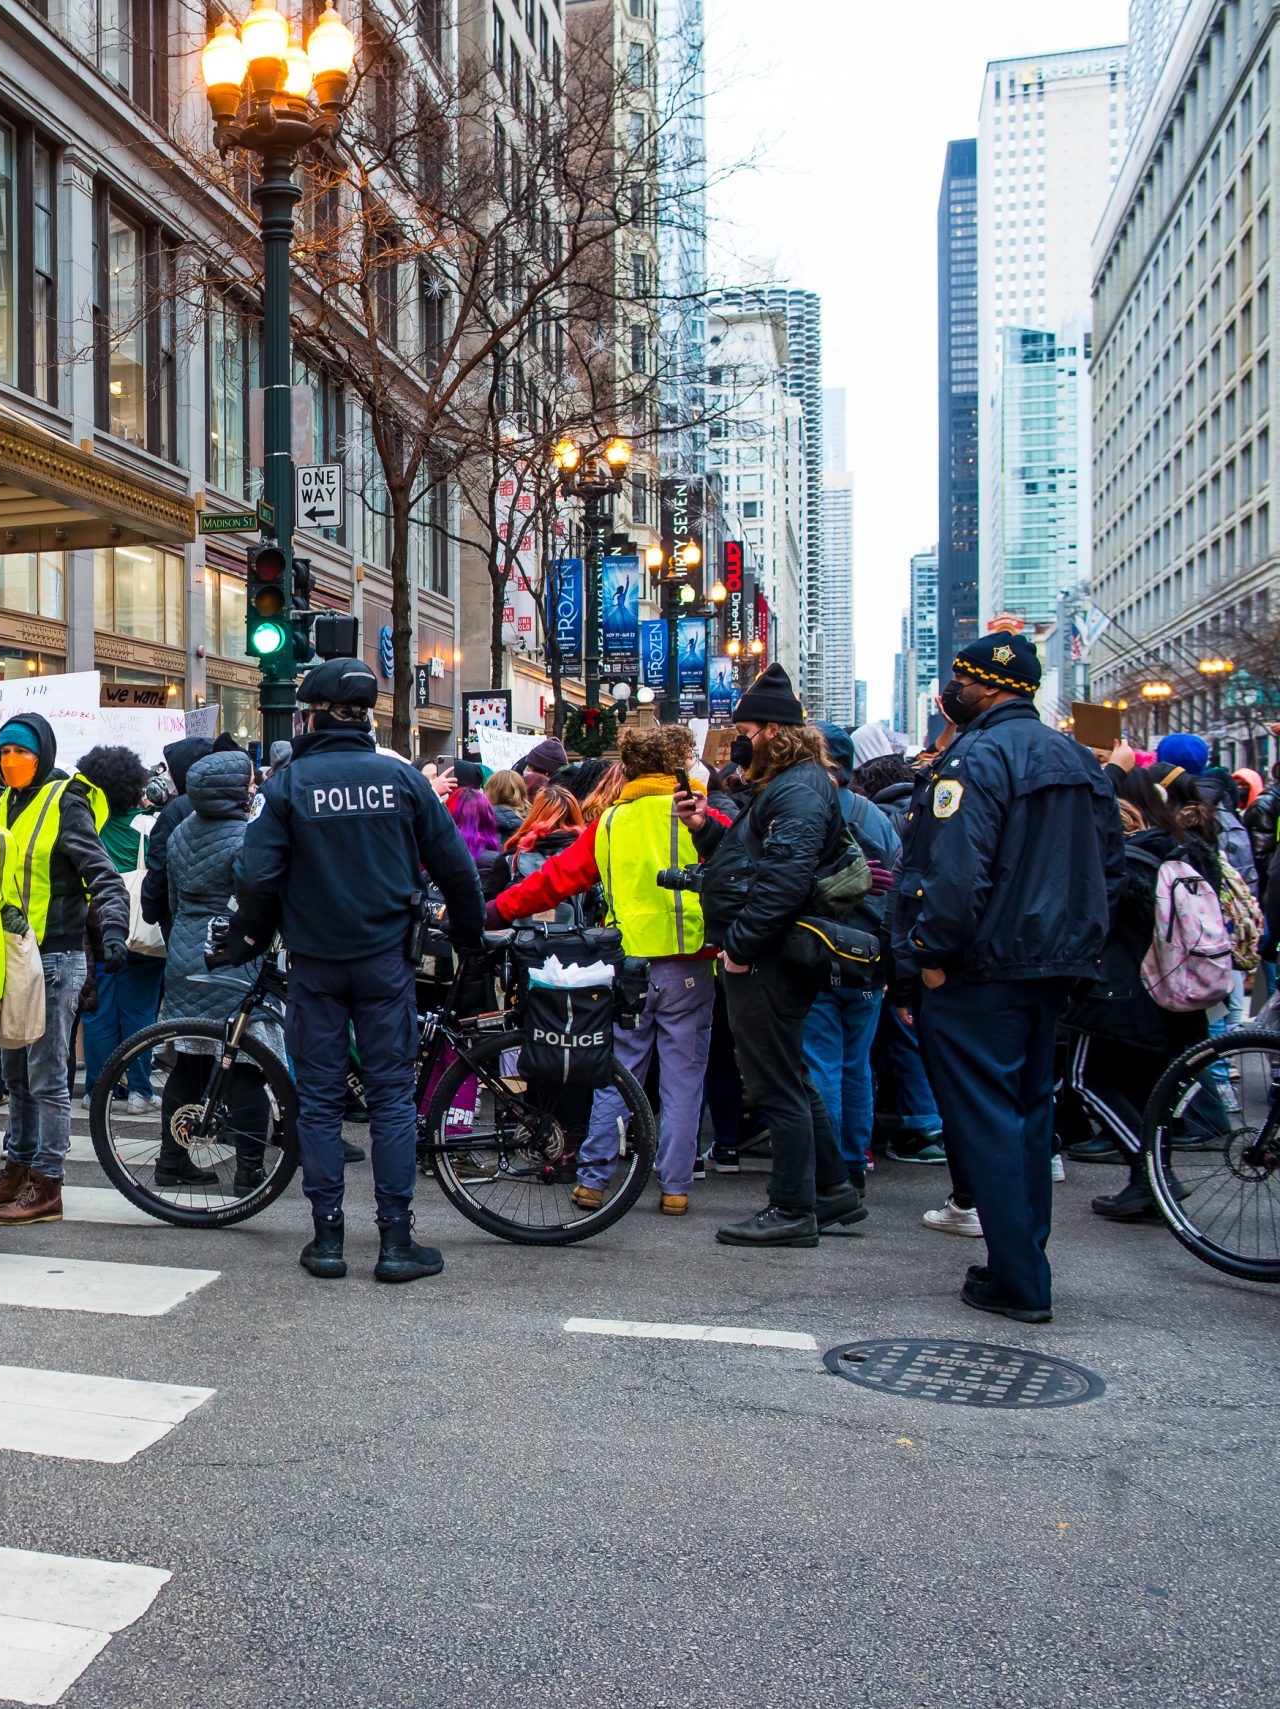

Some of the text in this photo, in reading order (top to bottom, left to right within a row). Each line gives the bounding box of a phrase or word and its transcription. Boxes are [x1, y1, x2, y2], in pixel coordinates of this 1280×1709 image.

[302, 470, 336, 486] ONE
[302, 487, 336, 503] WAY
[673, 484, 688, 535] SEVEN
[203, 518, 241, 529] MADISON
[673, 539, 688, 578] HIRTY
[557, 564, 579, 641] FROZEN
[647, 623, 665, 679] FROZEN
[419, 669, 427, 705] AT&T
[106, 688, 166, 706] We want
[472, 703, 500, 715] SAVE
[156, 713, 185, 732] HONK
[313, 785, 395, 813] POLICE
[533, 1028, 605, 1047] POLICE
[924, 1356, 1014, 1374] CHICAGO
[921, 1375, 991, 1391] SEWER
